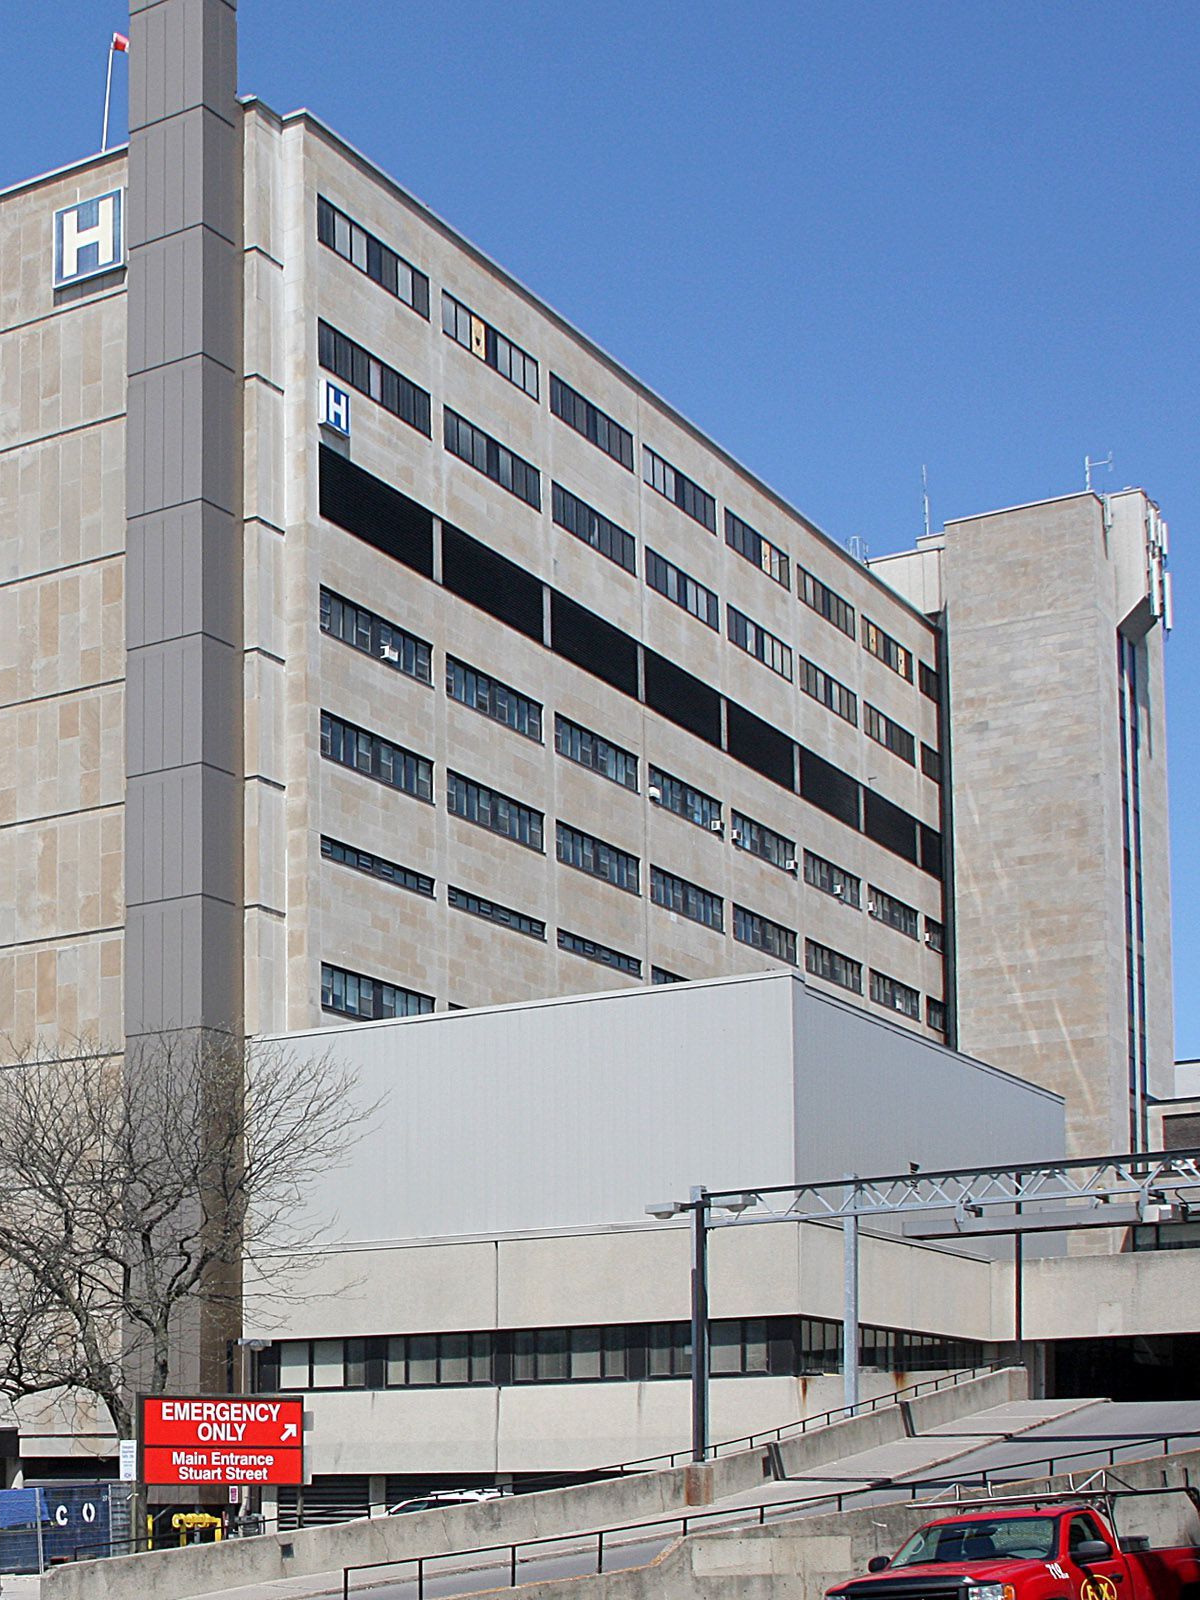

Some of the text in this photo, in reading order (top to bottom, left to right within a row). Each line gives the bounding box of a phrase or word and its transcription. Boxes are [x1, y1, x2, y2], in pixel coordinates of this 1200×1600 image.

[63, 197, 114, 279] H
[329, 386, 347, 432] H
[161, 1402, 281, 1422] EMERGENCY
[197, 1422, 247, 1442] ONLY
[172, 1451, 274, 1466] Main Entrance
[178, 1466, 268, 1481] Stuart Street
